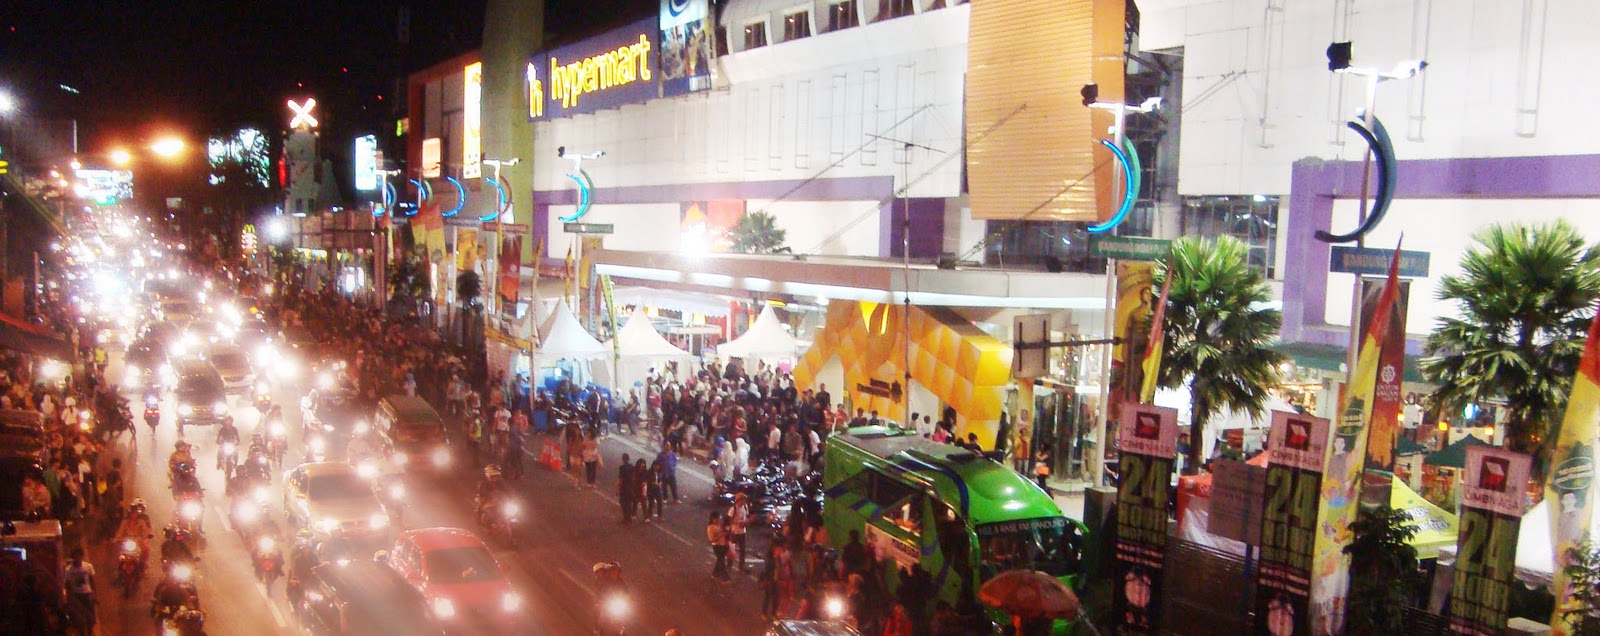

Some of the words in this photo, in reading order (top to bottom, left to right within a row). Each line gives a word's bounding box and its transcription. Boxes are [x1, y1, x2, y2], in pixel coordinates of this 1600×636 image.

[550, 33, 652, 109] hypermart
[1118, 455, 1169, 510] 24
[1264, 465, 1320, 530] 24
[1455, 509, 1519, 583] 24
